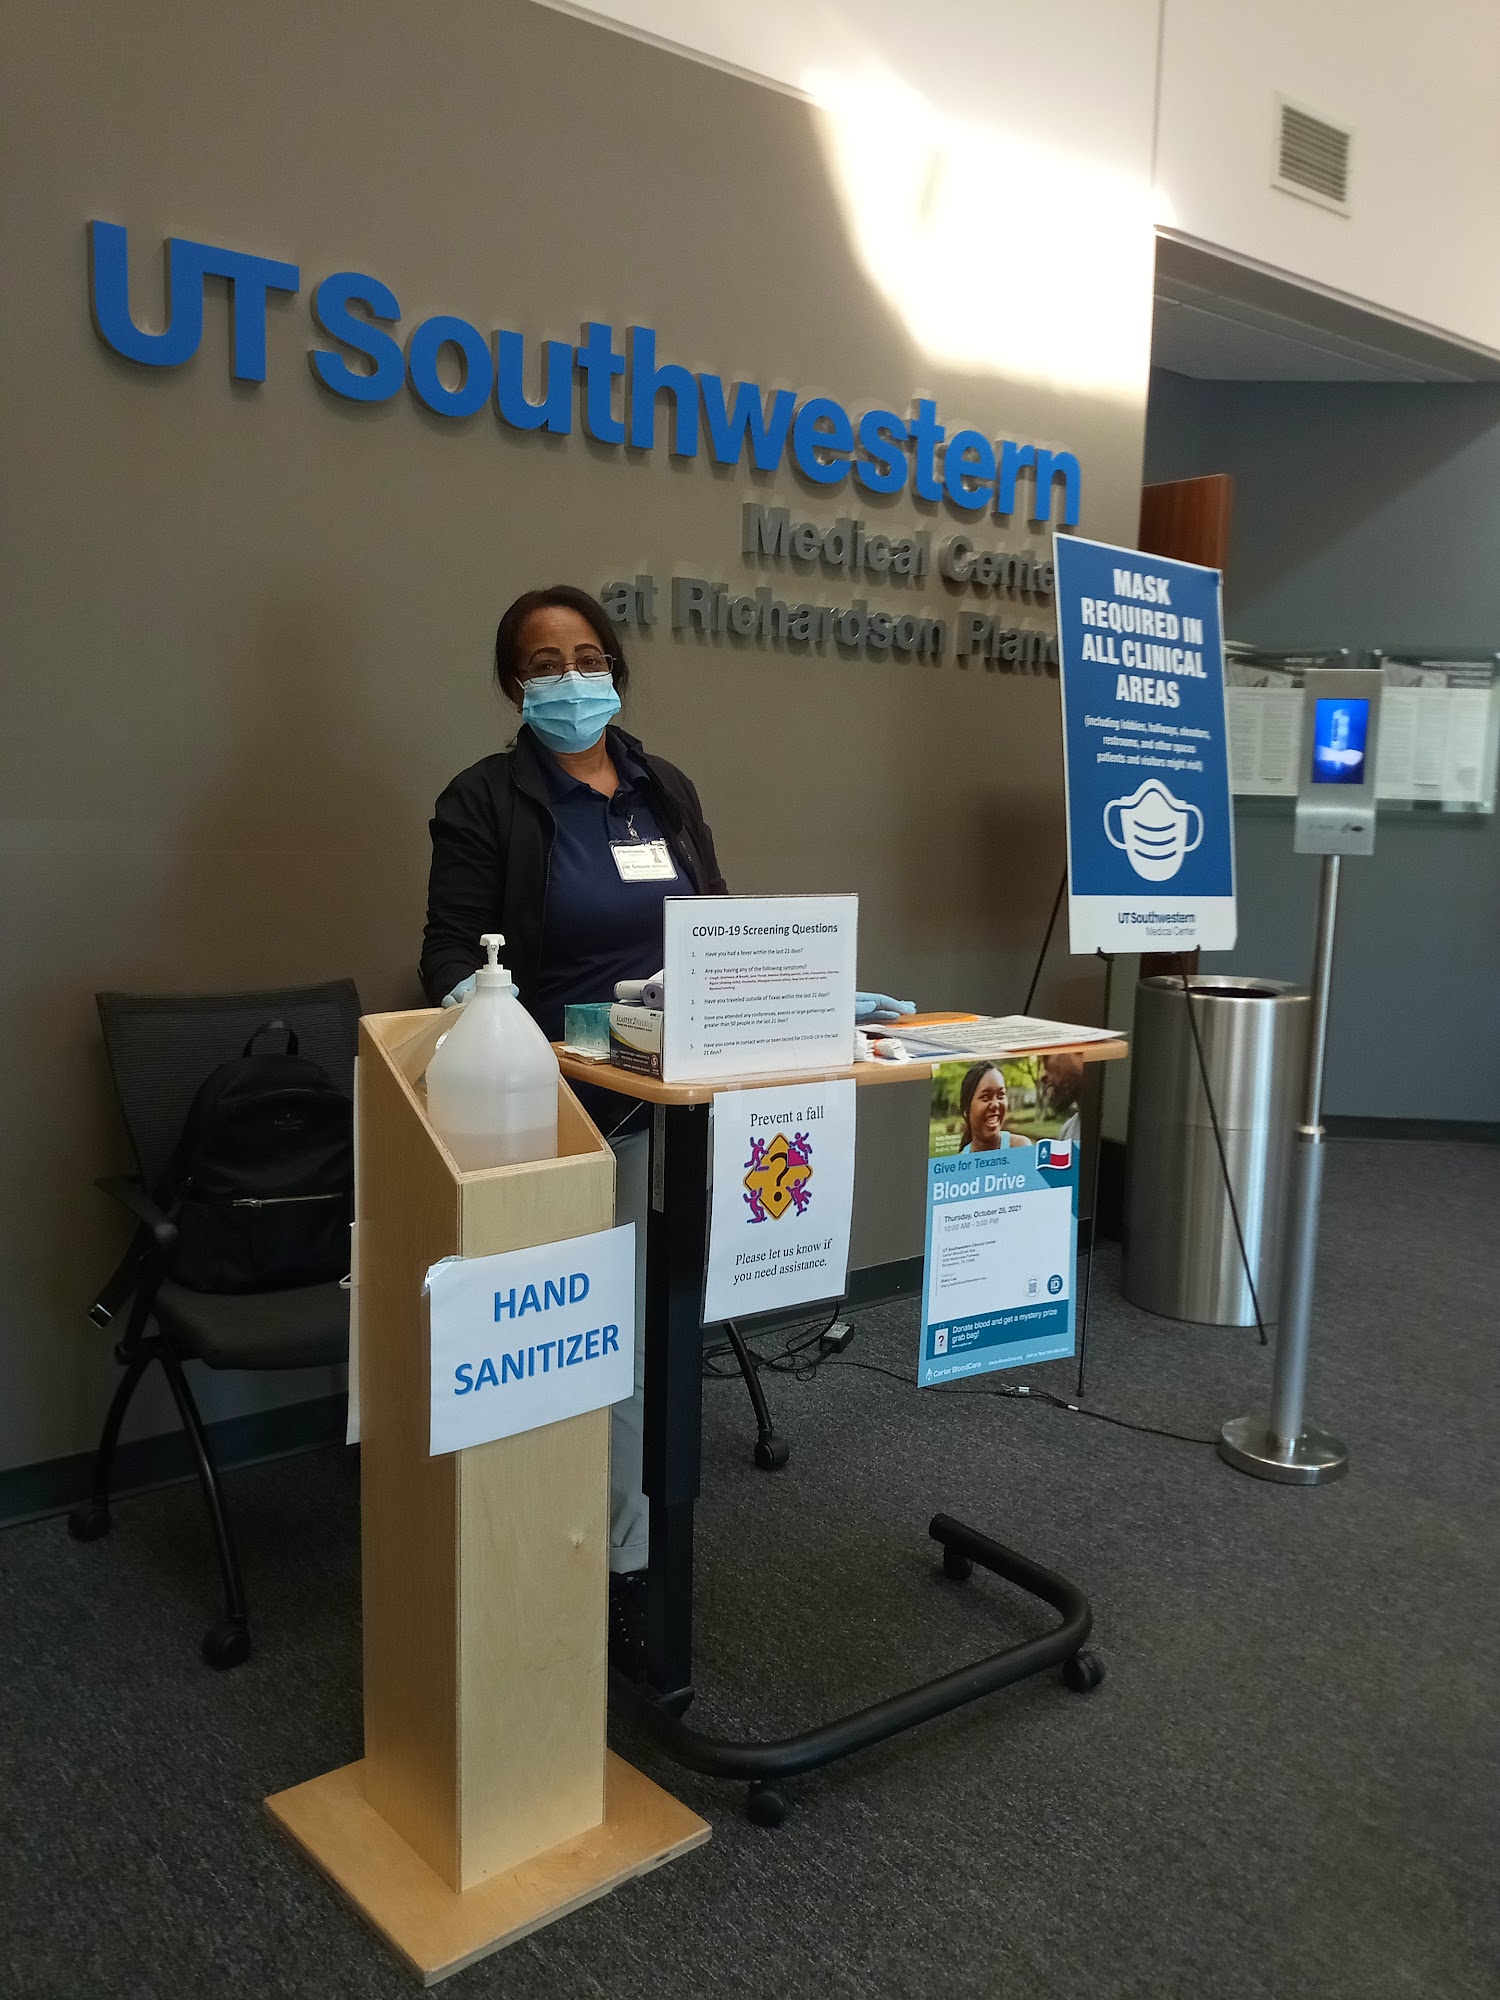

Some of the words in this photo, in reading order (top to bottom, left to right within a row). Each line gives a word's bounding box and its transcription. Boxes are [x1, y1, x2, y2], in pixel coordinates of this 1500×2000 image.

[307, 272, 1081, 525] Southwestern
[742, 502, 928, 576] Medical
[939, 535, 1054, 594] Cente
[1113, 568, 1172, 605] MASK
[602, 575, 656, 626] at
[671, 577, 946, 655] Richardson
[1081, 597, 1180, 640] REQUIRED
[1182, 617, 1203, 645] IN
[1081, 633, 1120, 665] ALL
[1121, 639, 1208, 678] CLINICAL
[1115, 673, 1181, 708] AREAS
[1126, 755, 1140, 765] and
[692, 925, 740, 937] COVID-19
[742, 924, 790, 936] Screening
[791, 922, 838, 935] Questions
[717, 951, 727, 959] you
[714, 968, 724, 976] you
[750, 1110, 793, 1127] Prevent
[796, 1111, 803, 1121] a
[806, 1105, 824, 1120] fall
[933, 1162, 956, 1174] Give
[958, 1160, 972, 1171] for
[974, 1156, 1010, 1169] Texans.
[933, 1176, 980, 1201] Blood
[984, 1173, 1027, 1193] Drive
[944, 1213, 972, 1223] Thursday,
[973, 1209, 997, 1218] October
[1008, 1204, 1022, 1213] 2021
[735, 1253, 766, 1265] Please
[768, 1248, 781, 1260] let
[783, 1247, 794, 1257] us
[796, 1244, 821, 1255] know
[823, 1238, 833, 1250] if
[733, 1272, 752, 1285] you
[754, 1264, 777, 1279] need
[779, 1258, 827, 1274] assistance.
[494, 1272, 590, 1322] HAND
[952, 1321, 974, 1334] Donate
[974, 1318, 991, 1330] blood
[991, 1316, 1003, 1326] and
[1003, 1315, 1014, 1326] get
[1019, 1310, 1042, 1321] mystery
[1042, 1308, 1059, 1318] prize
[951, 1333, 966, 1344] grab
[966, 1330, 980, 1341] bag!
[454, 1324, 620, 1396] SANITIZER
[933, 1367, 952, 1378] Carter
[952, 1361, 982, 1373] BloodCare
